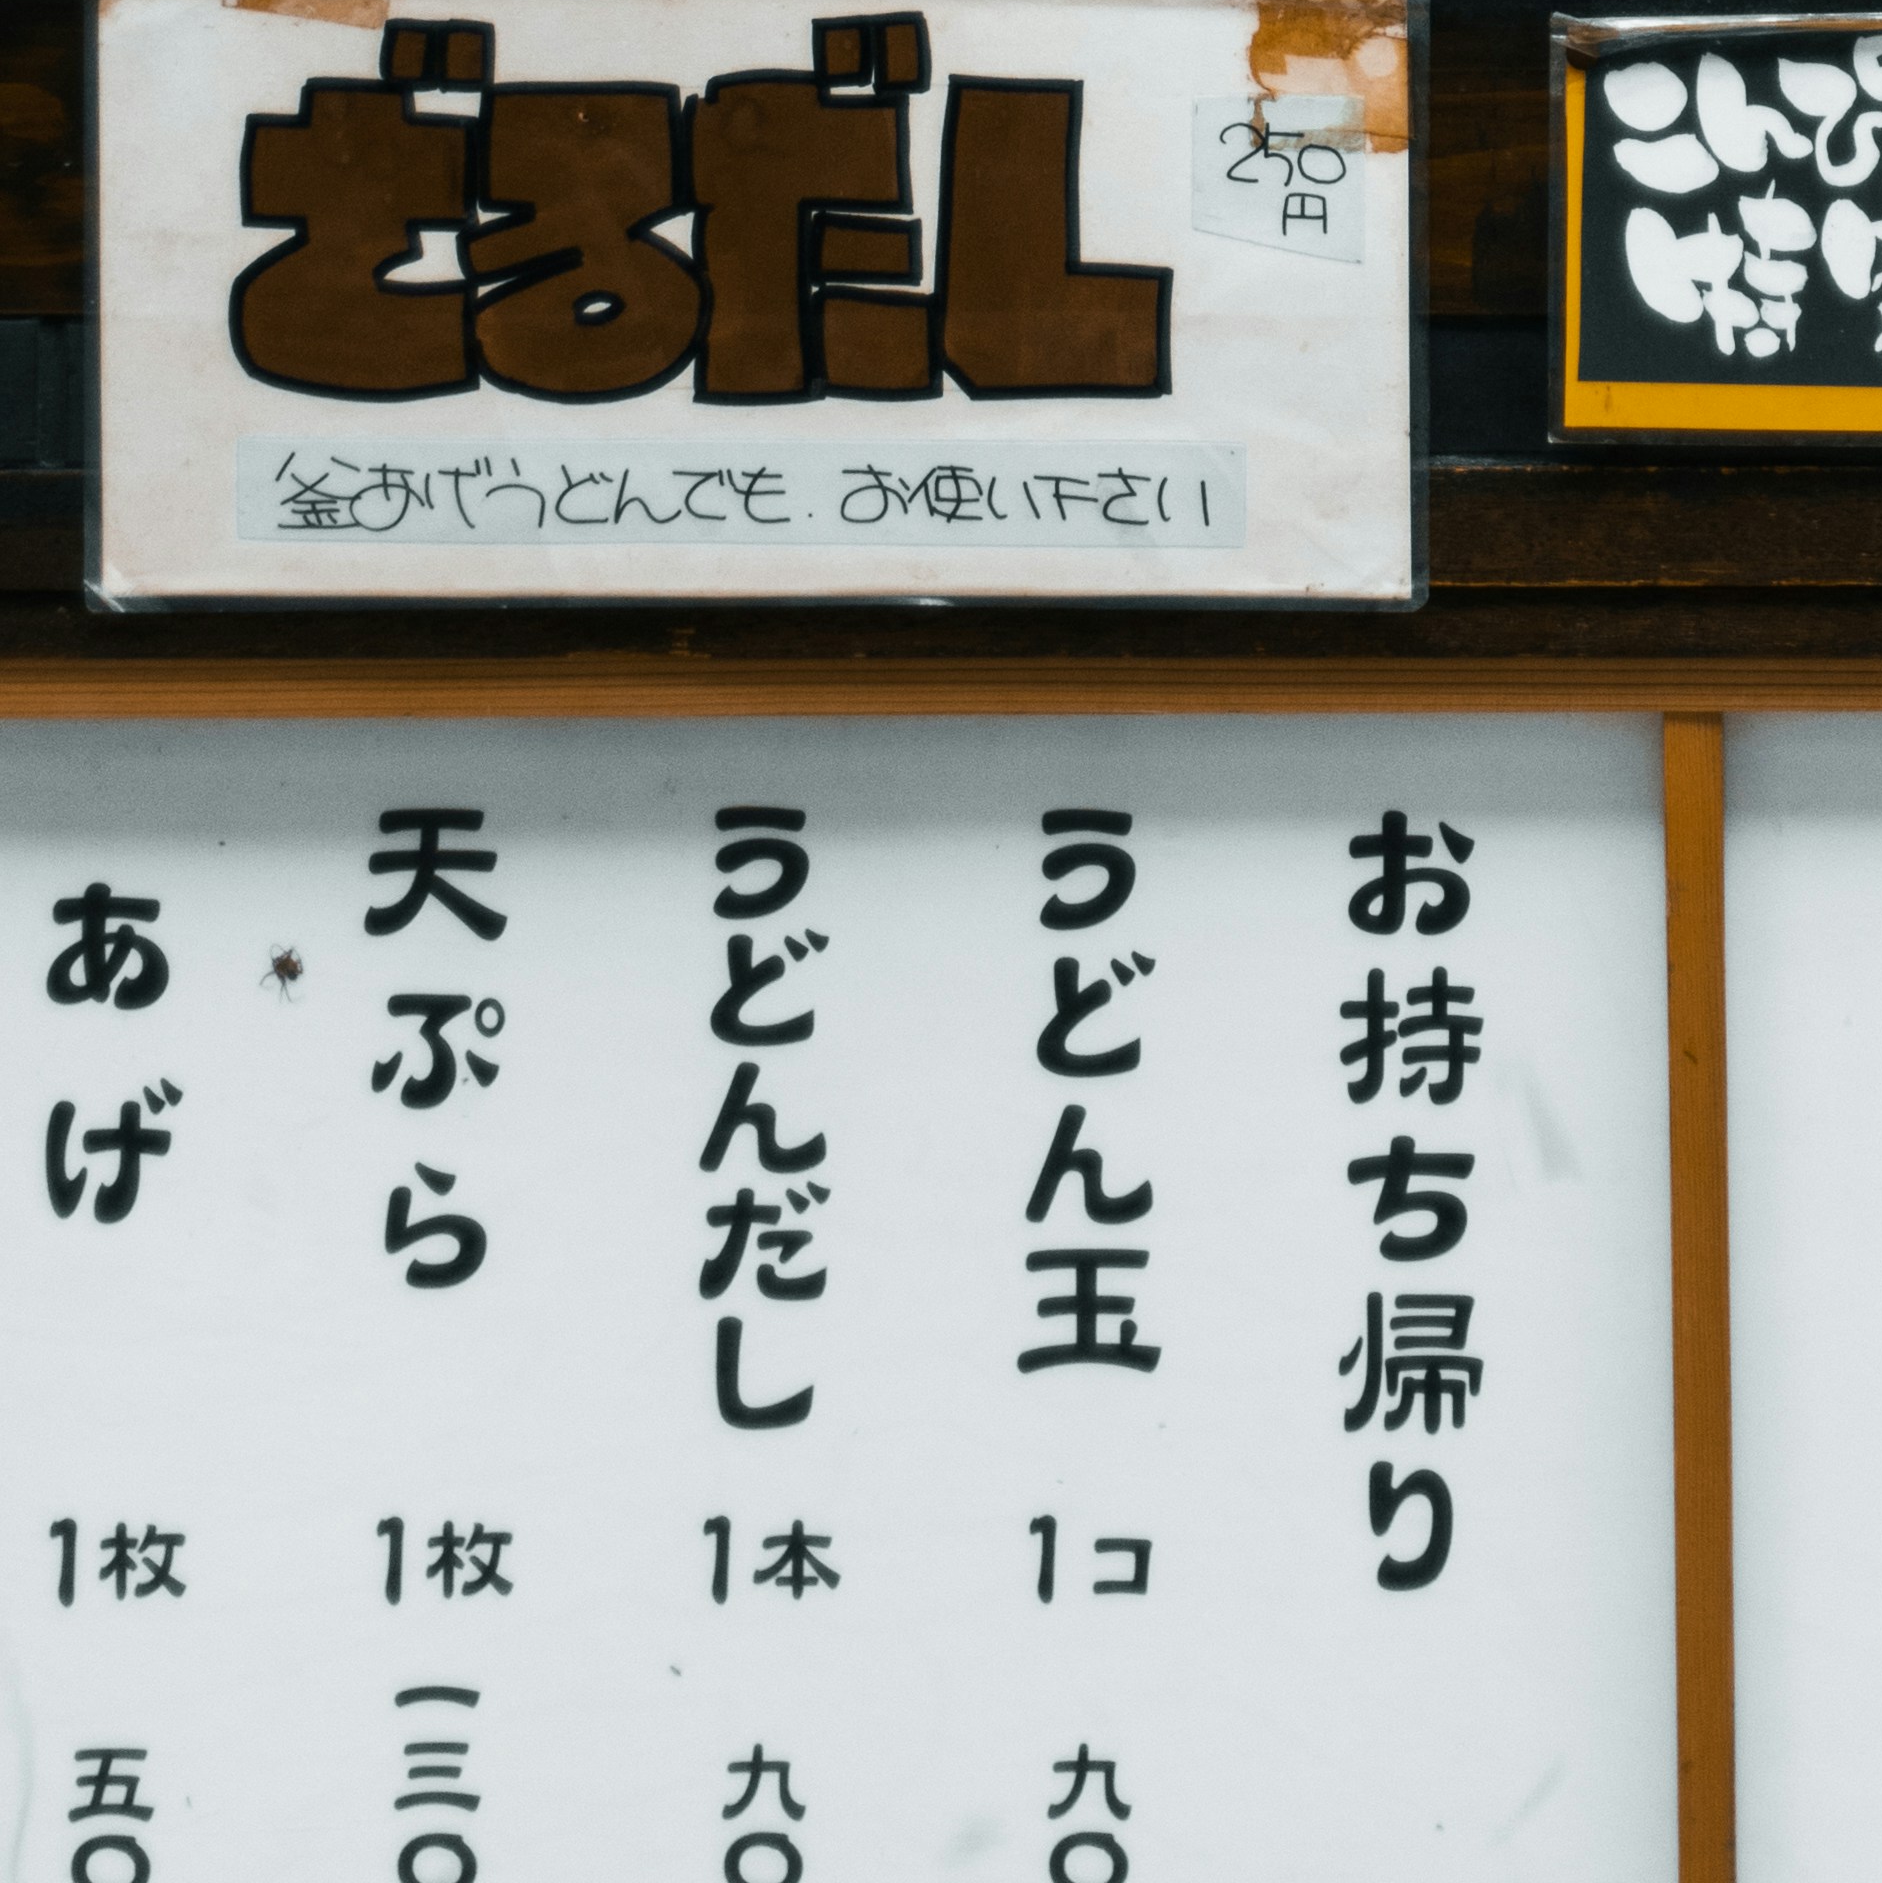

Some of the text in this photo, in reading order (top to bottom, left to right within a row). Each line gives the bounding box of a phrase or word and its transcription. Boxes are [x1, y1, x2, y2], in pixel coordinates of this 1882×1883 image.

[230, 12, 1173, 403] ざるだし
[1219, 122, 1346, 187] 250
[1282, 192, 1328, 236] 円
[45, 881, 183, 1224] あげ
[363, 796, 508, 1289] 天ぷら
[698, 799, 830, 1430] うどんだし
[1017, 805, 1161, 1374] うどん玉
[1338, 807, 1484, 1591] お持ち帰り
[49, 1517, 186, 1607] 1枚
[376, 1516, 513, 1605] 1枚
[703, 1515, 840, 1604] 1本
[1029, 1514, 1152, 1604] 1コ
